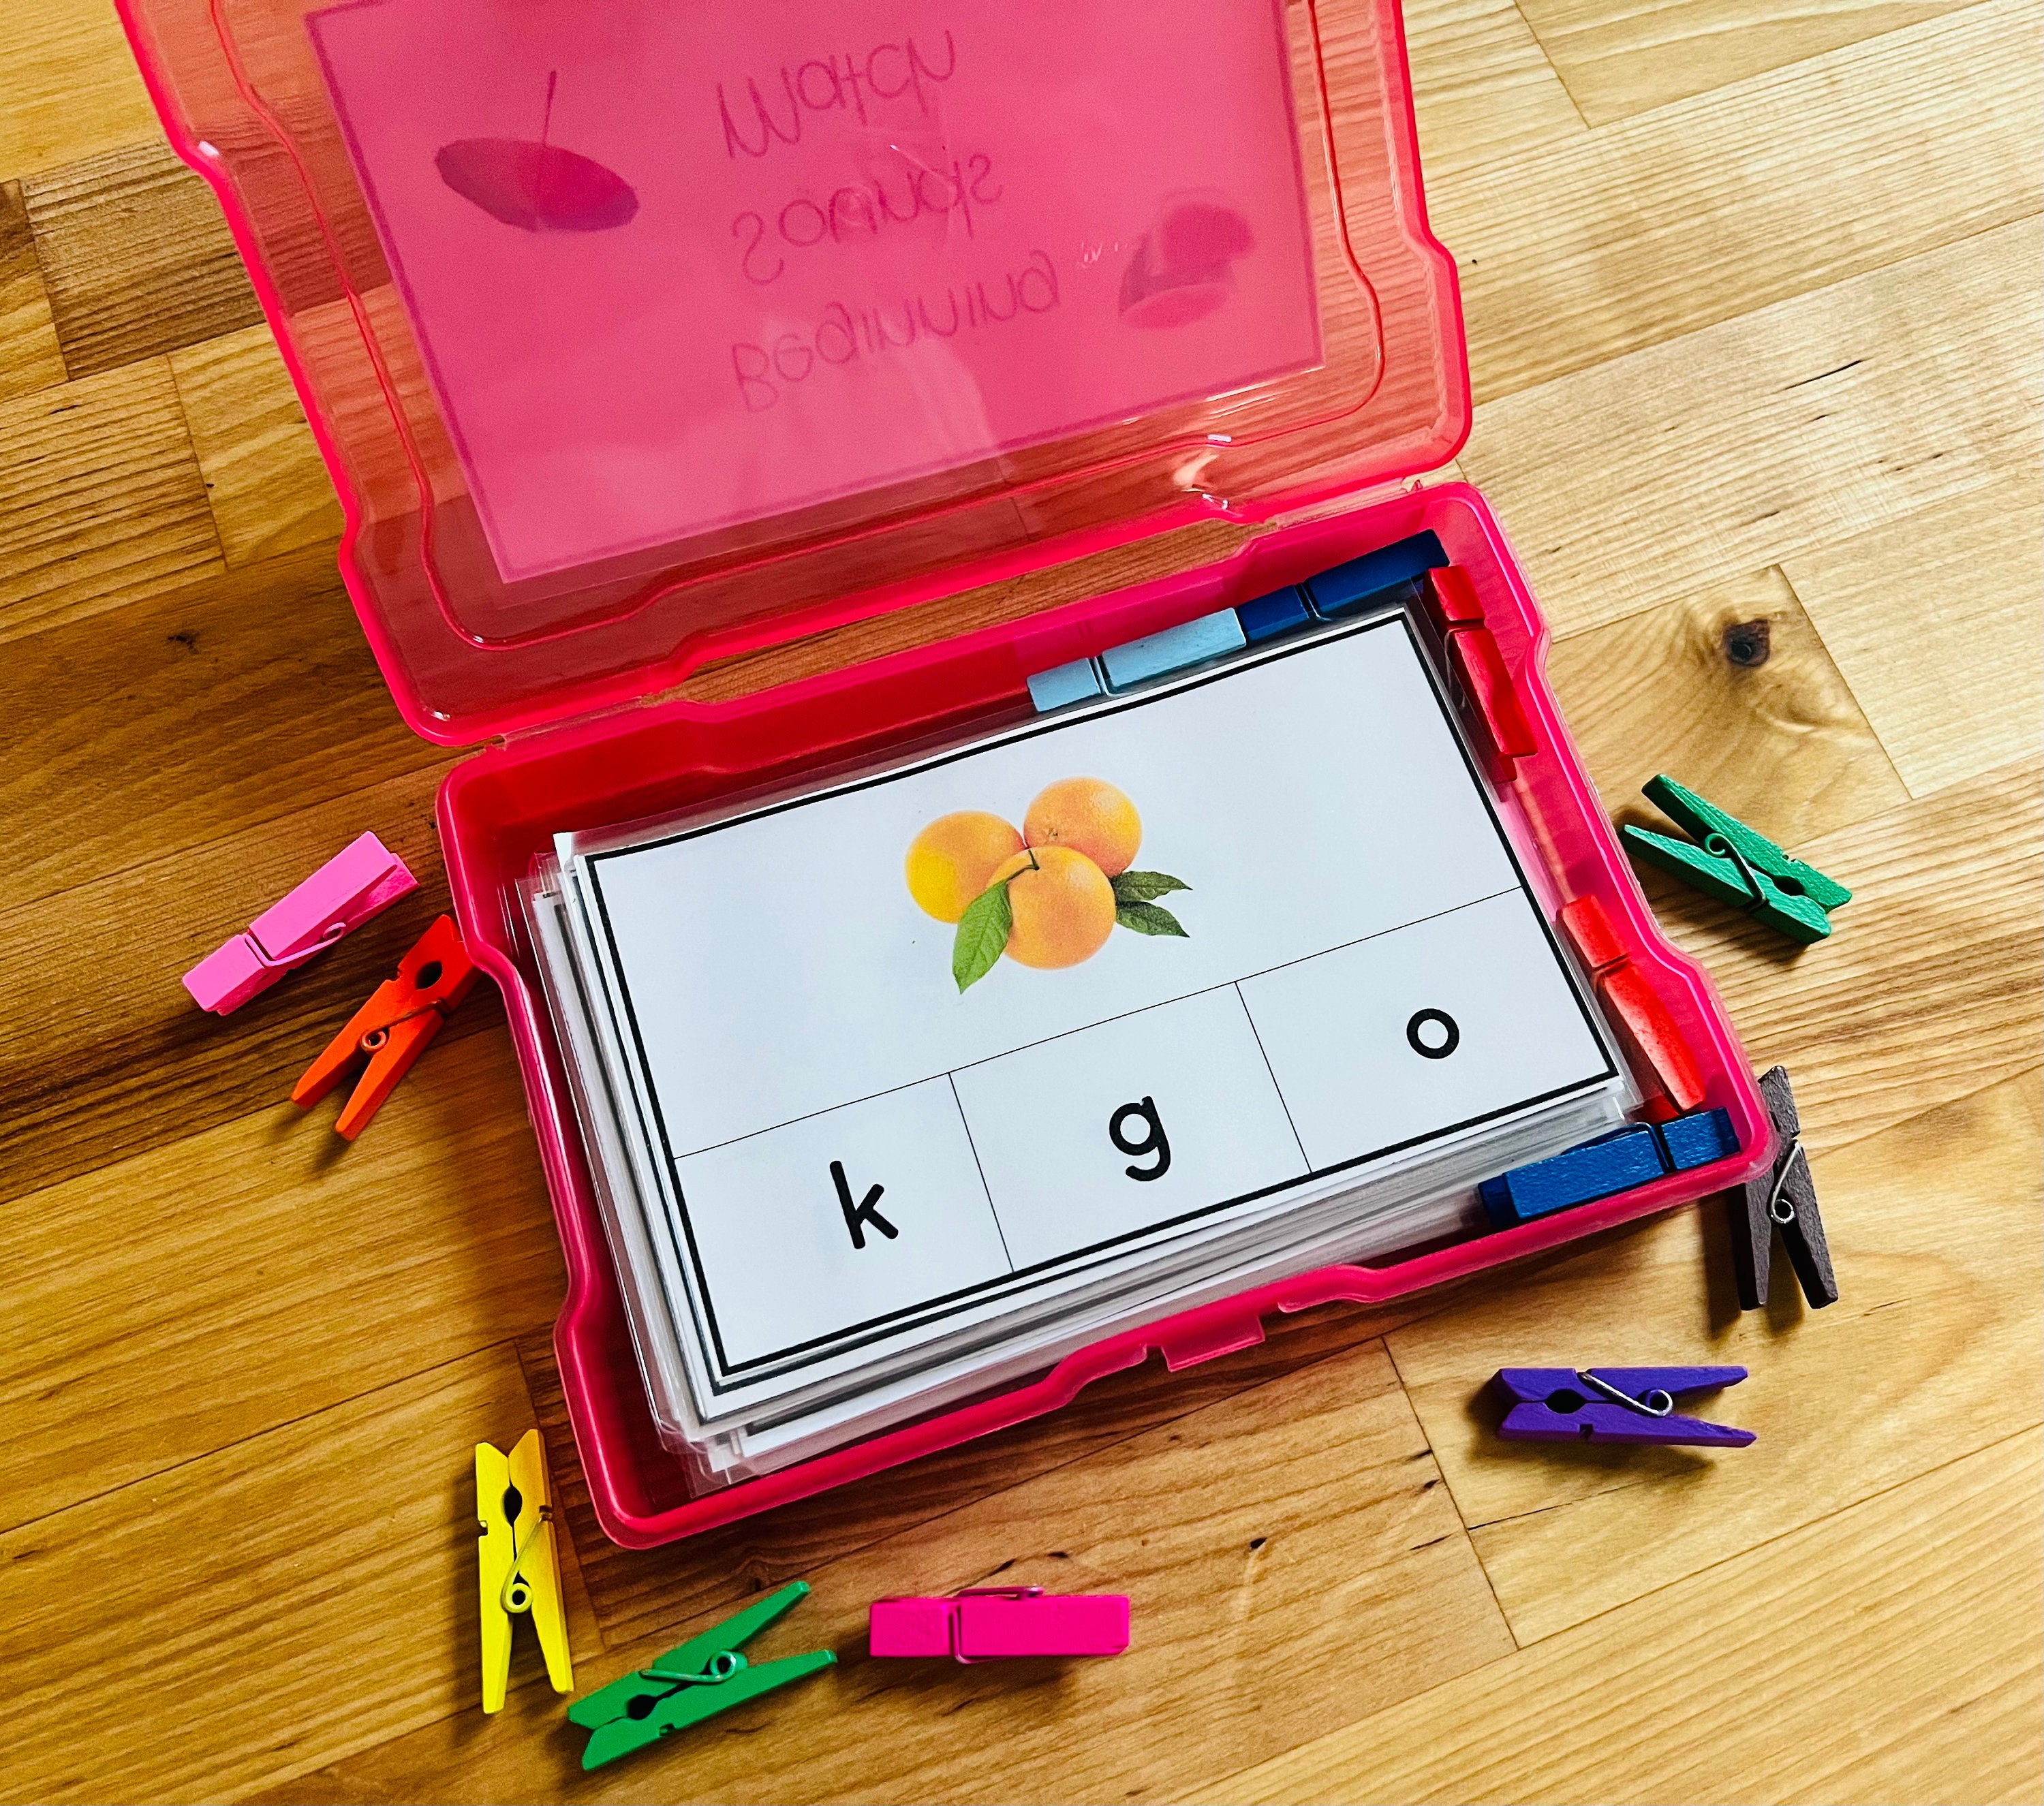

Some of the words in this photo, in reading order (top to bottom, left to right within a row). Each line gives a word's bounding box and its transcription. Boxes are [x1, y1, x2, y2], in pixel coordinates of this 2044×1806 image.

[1406, 1008, 1460, 1059] o
[1109, 1095, 1171, 1182] g
[829, 1160, 899, 1249] k
